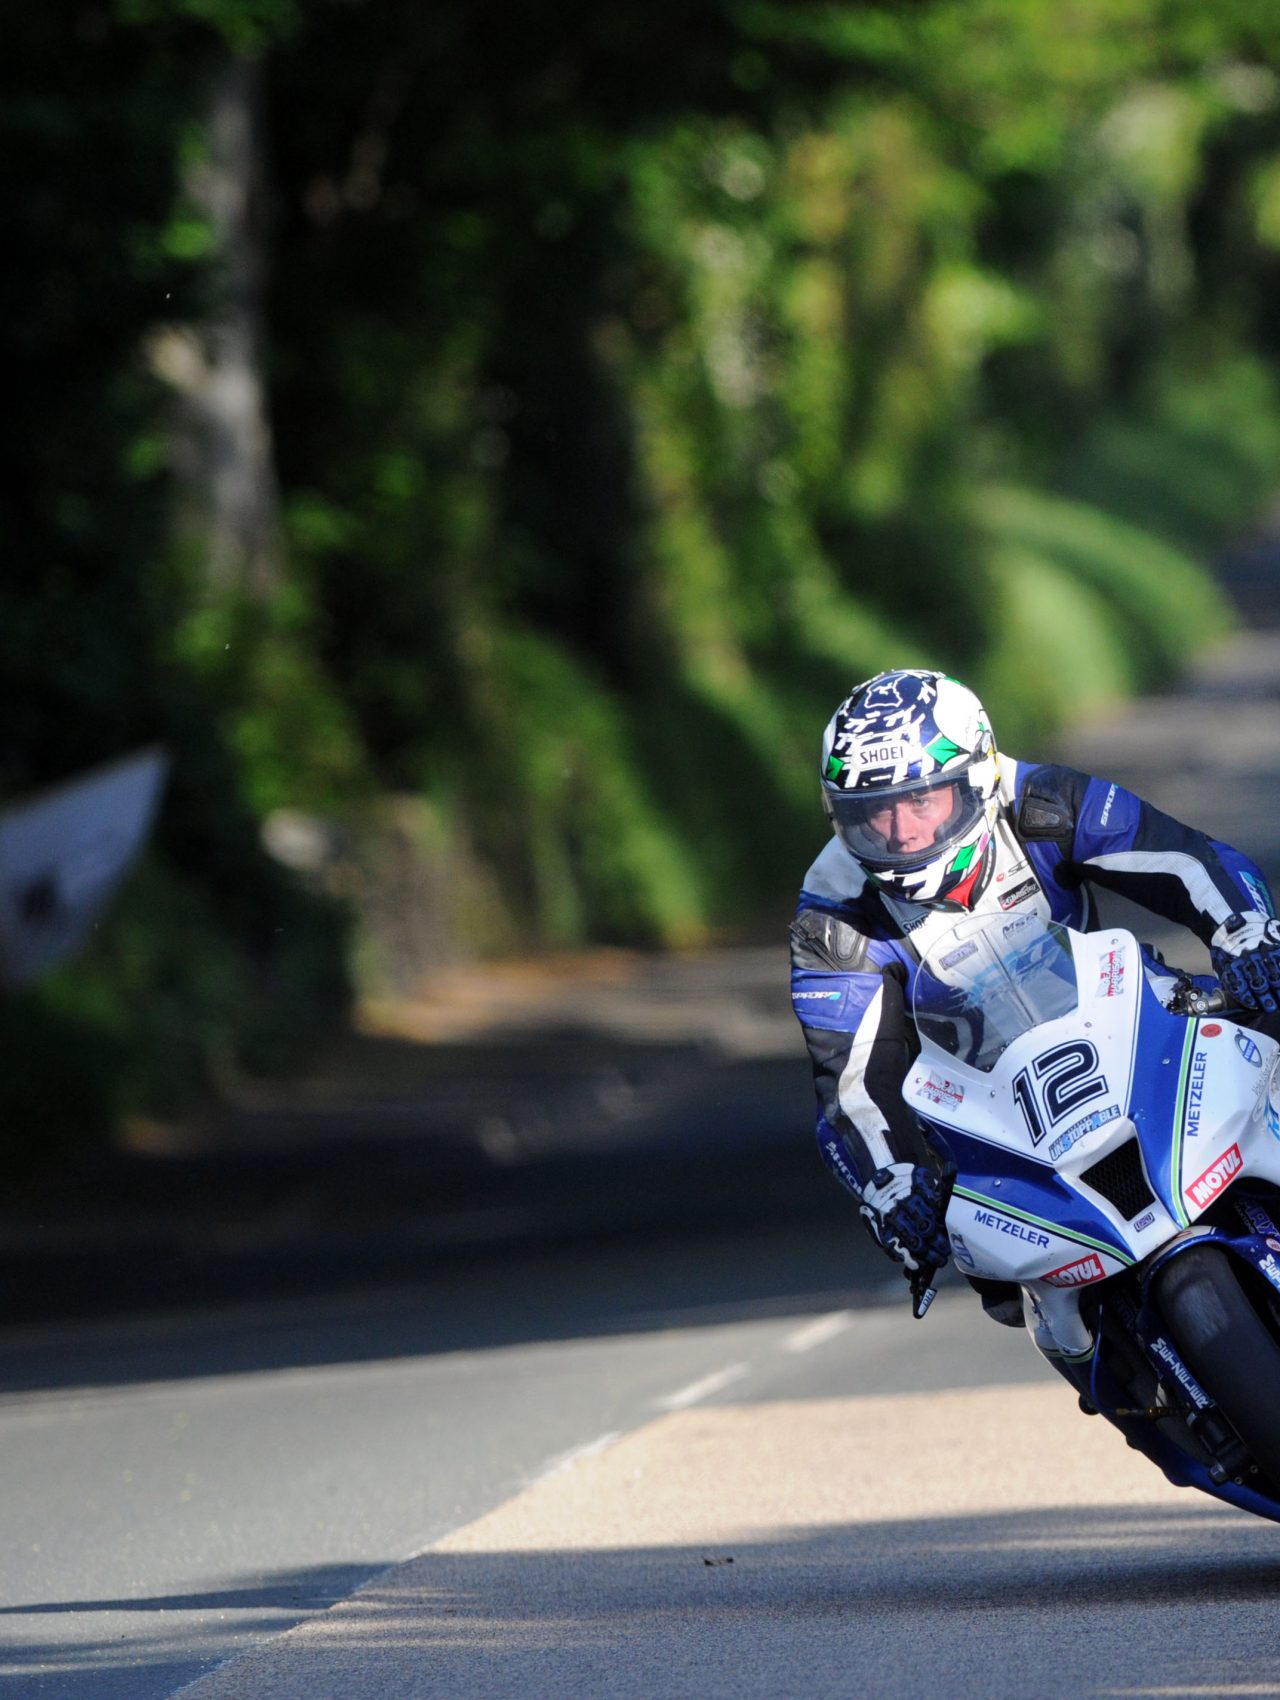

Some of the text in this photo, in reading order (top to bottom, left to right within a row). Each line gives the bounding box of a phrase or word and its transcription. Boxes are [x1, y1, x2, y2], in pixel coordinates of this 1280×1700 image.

[859, 745, 904, 765] SHOEI
[1012, 1039, 1110, 1149] 12
[1187, 1052, 1207, 1137] METZELER
[1048, 1104, 1121, 1161] UNSTOPPABLE
[1191, 1150, 1241, 1205] MOTUL
[974, 1210, 1050, 1249] METZELER
[1048, 1258, 1101, 1286] MOTUL
[1150, 1337, 1209, 1409] METZELER
